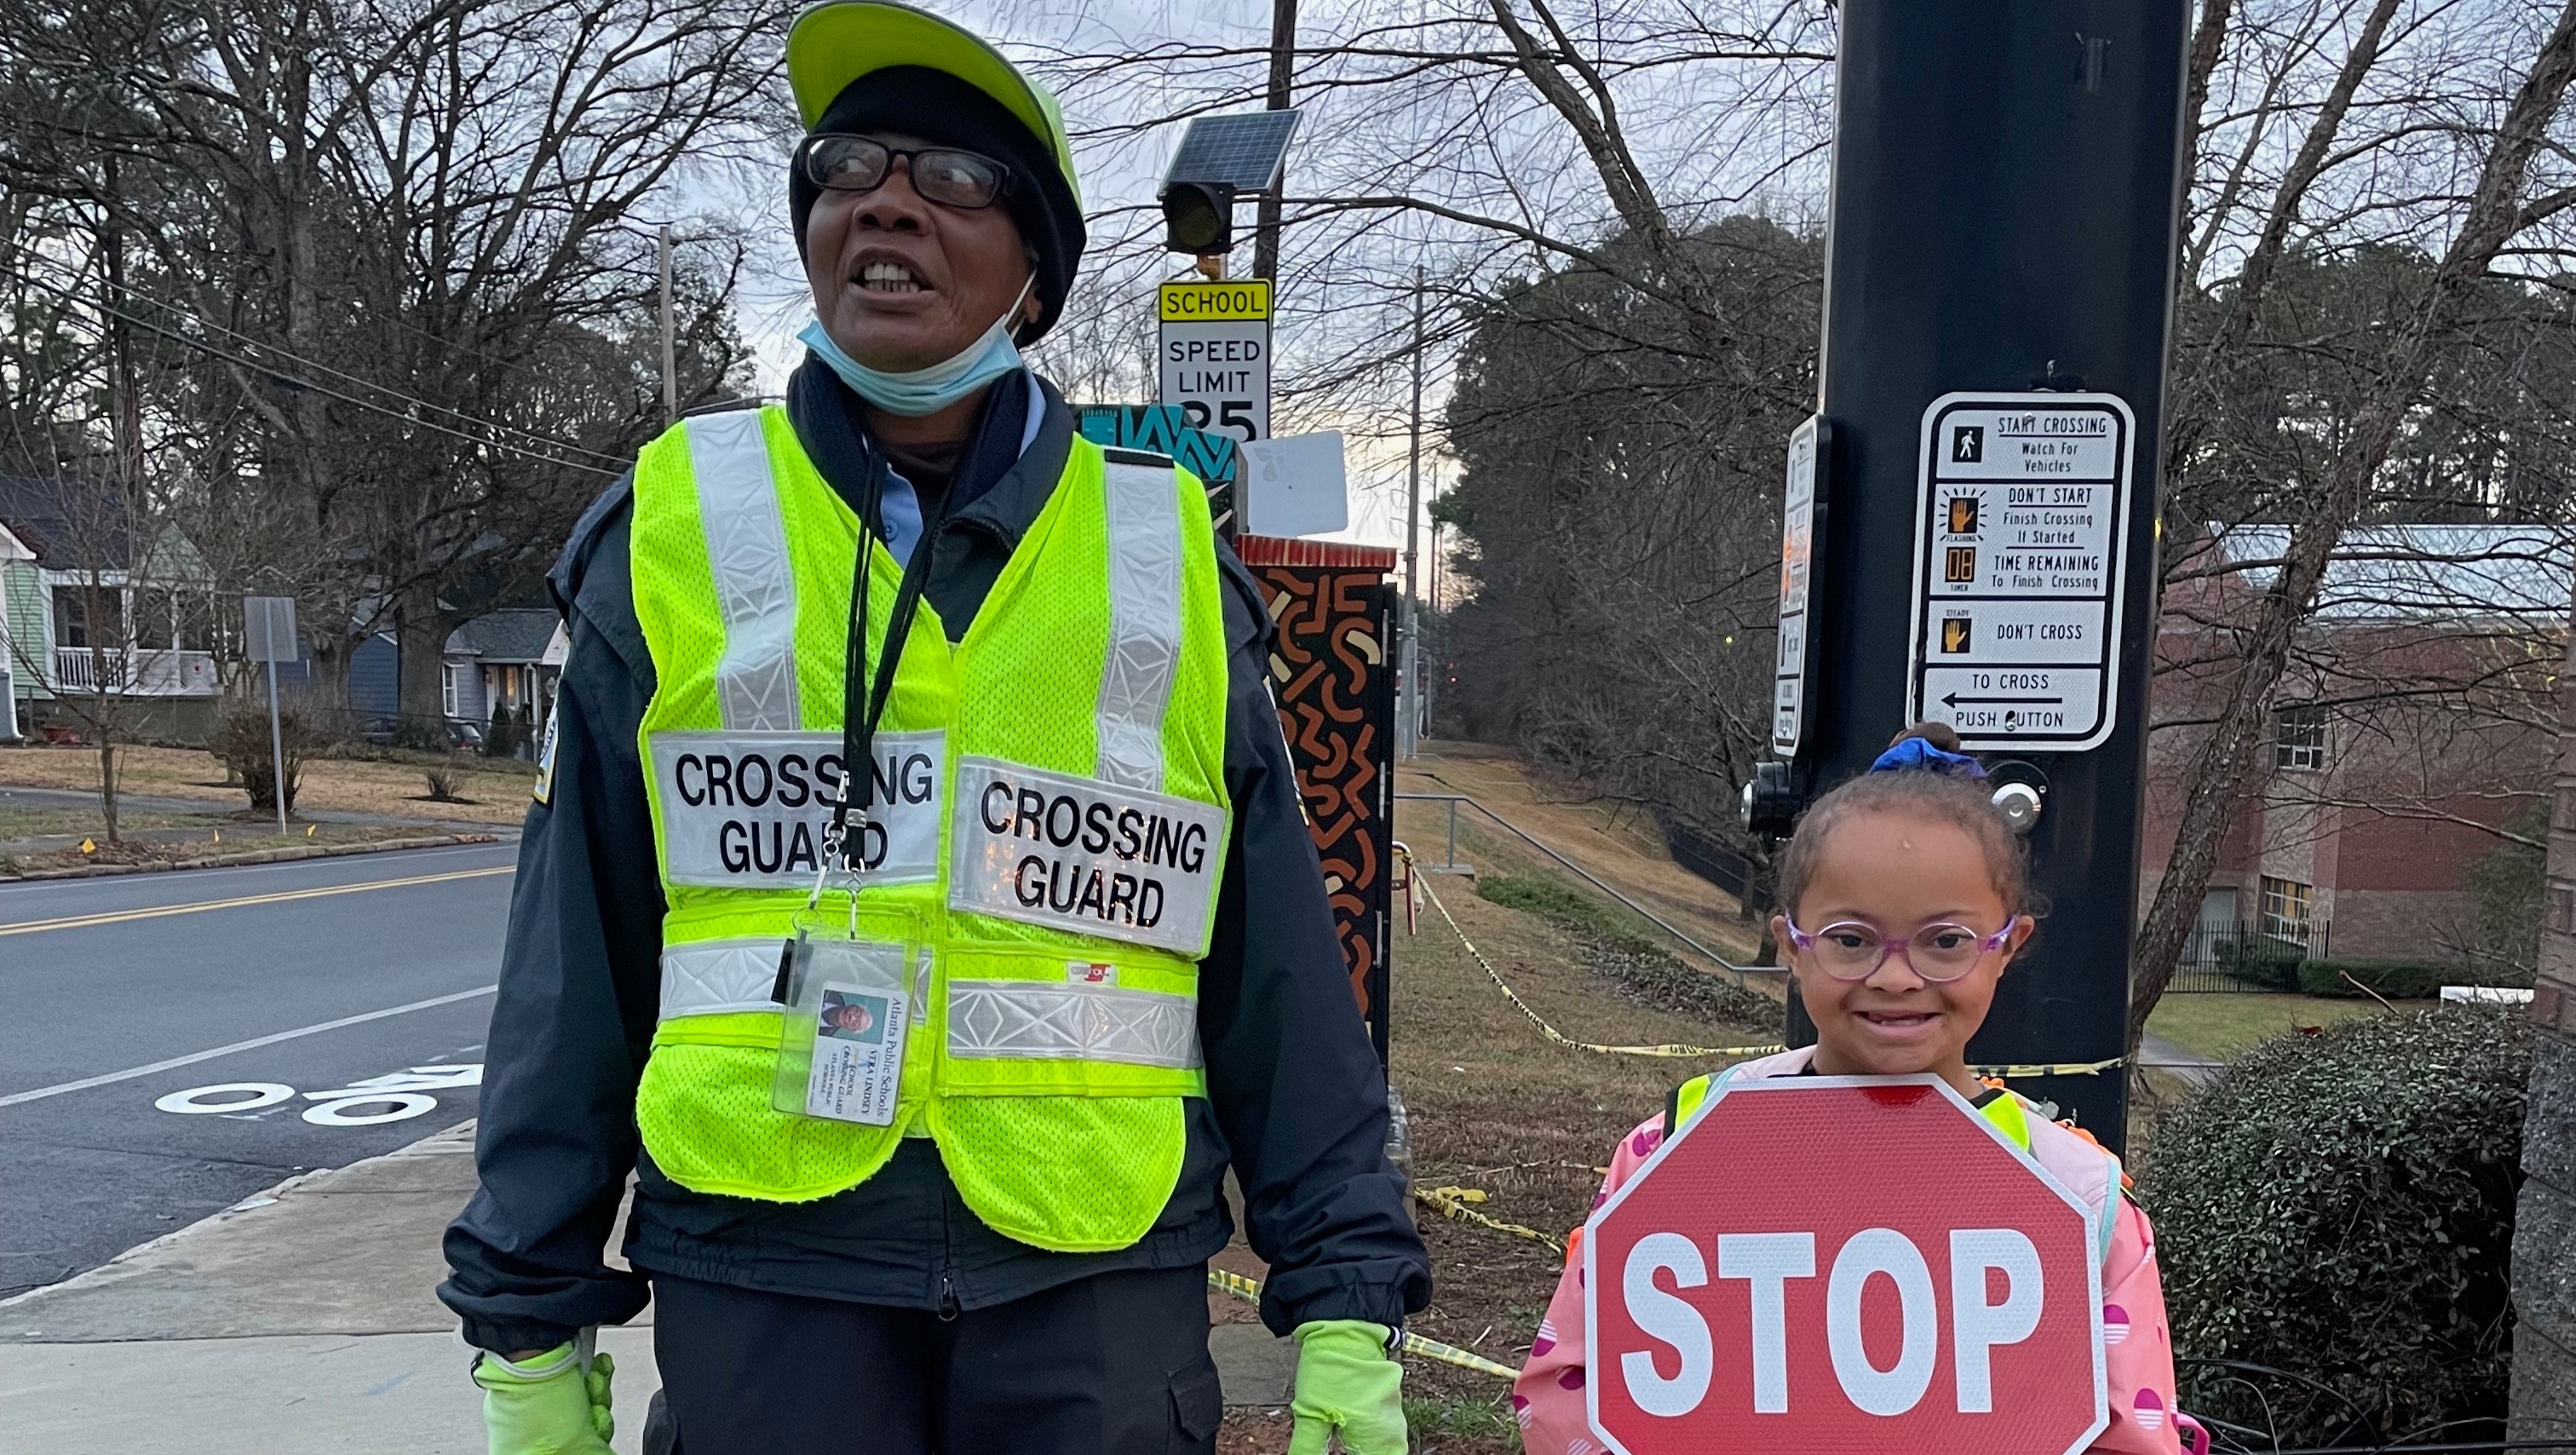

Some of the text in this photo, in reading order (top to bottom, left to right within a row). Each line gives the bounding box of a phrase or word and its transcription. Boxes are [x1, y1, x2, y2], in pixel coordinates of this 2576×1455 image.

[1167, 290, 1264, 313] SCHOOL
[1170, 340, 1260, 362] SPEED
[1179, 371, 1251, 393] LIMIT
[1998, 417, 2107, 433] START CROSSING
[2021, 441, 2079, 455] Watch For
[2025, 459, 2071, 472] Vehicles
[2009, 487, 2092, 503] DON'T START
[2004, 511, 2093, 528] Finish Crossing
[2018, 530, 2075, 543] If Started
[1994, 555, 2099, 571] TIME REMAINING
[1992, 574, 2098, 591] To Finish Crossing
[1998, 624, 2083, 640] DON'T CROSS
[1972, 674, 2050, 689] TO CROSS
[1956, 711, 2063, 727] PUSH UTTON
[676, 754, 934, 808] CROSSNG
[981, 781, 1207, 874] CROSSING
[720, 820, 888, 874] GUAD
[1015, 854, 1164, 929] GUARD
[877, 997, 902, 1117] Atlanta Public Schools
[846, 1065, 857, 1096] SCHOOL
[1620, 1227, 2044, 1418] STOP
